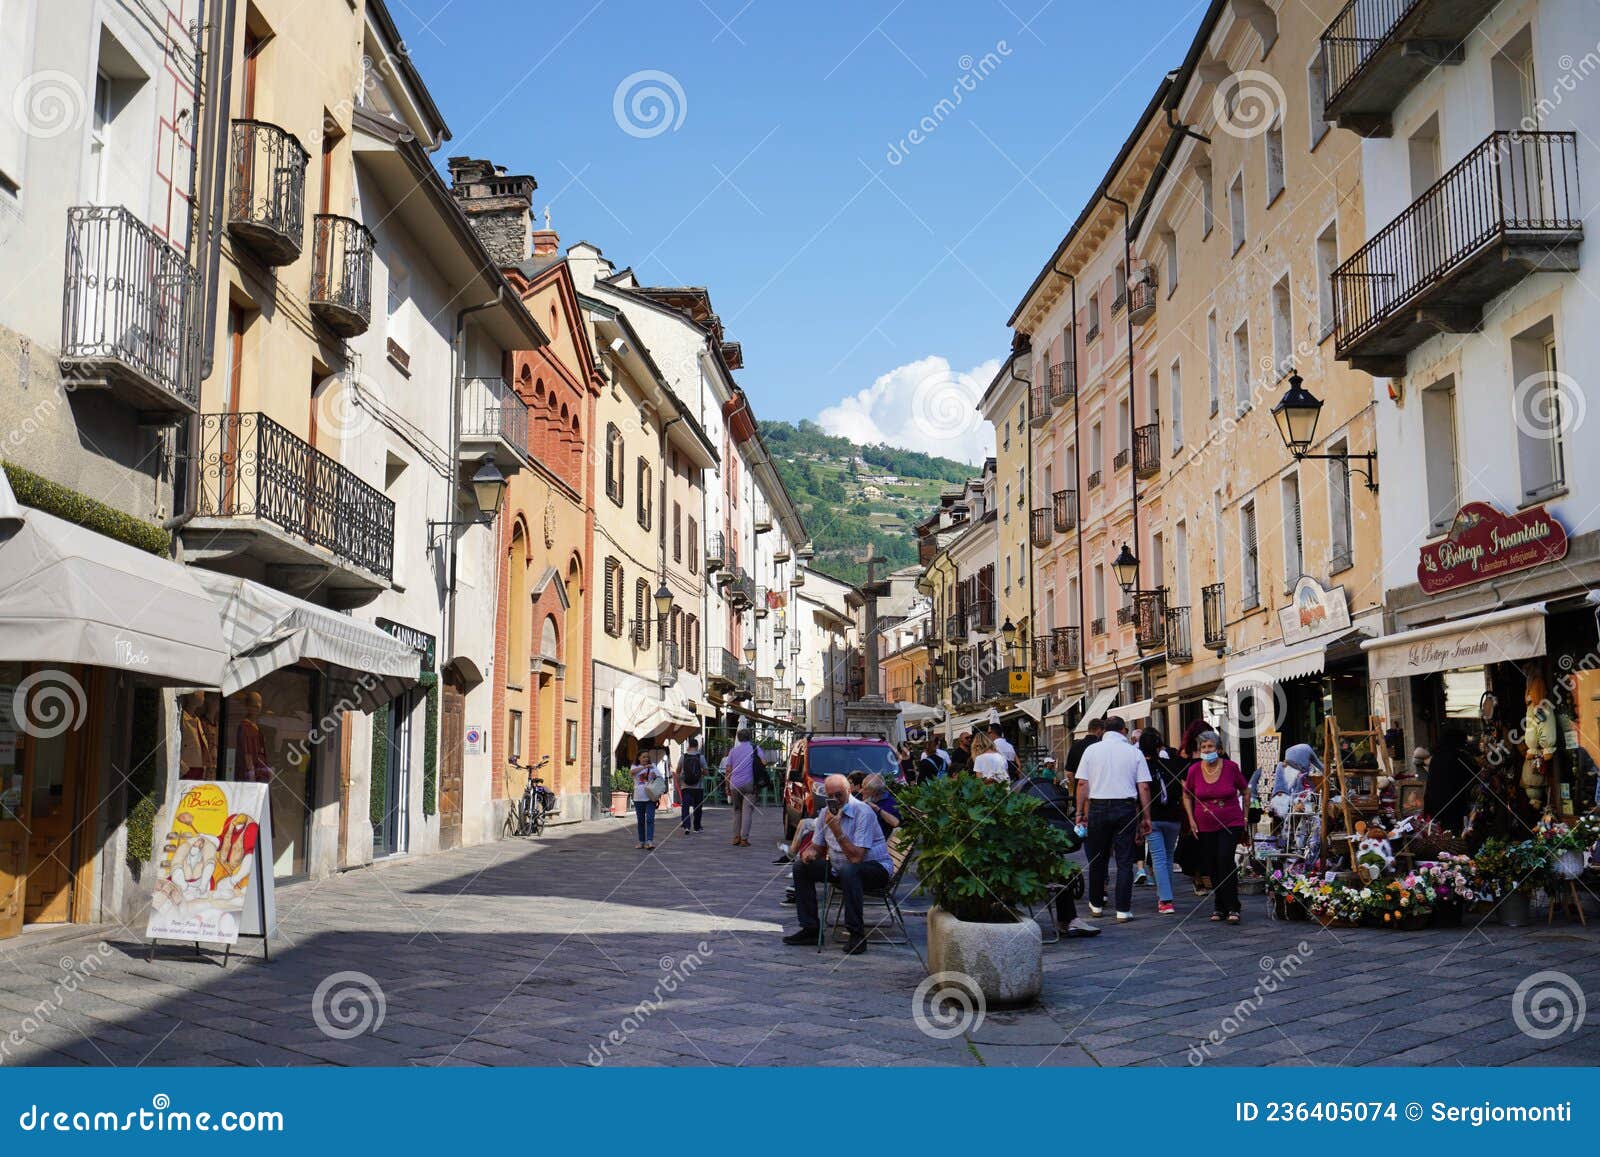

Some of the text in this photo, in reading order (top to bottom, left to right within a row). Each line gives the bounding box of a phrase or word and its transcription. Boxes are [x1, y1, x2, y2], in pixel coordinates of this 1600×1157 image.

[1438, 540, 1485, 572] Bottega
[1489, 519, 1550, 555] Incantata
[391, 624, 427, 651] CANNABIS
